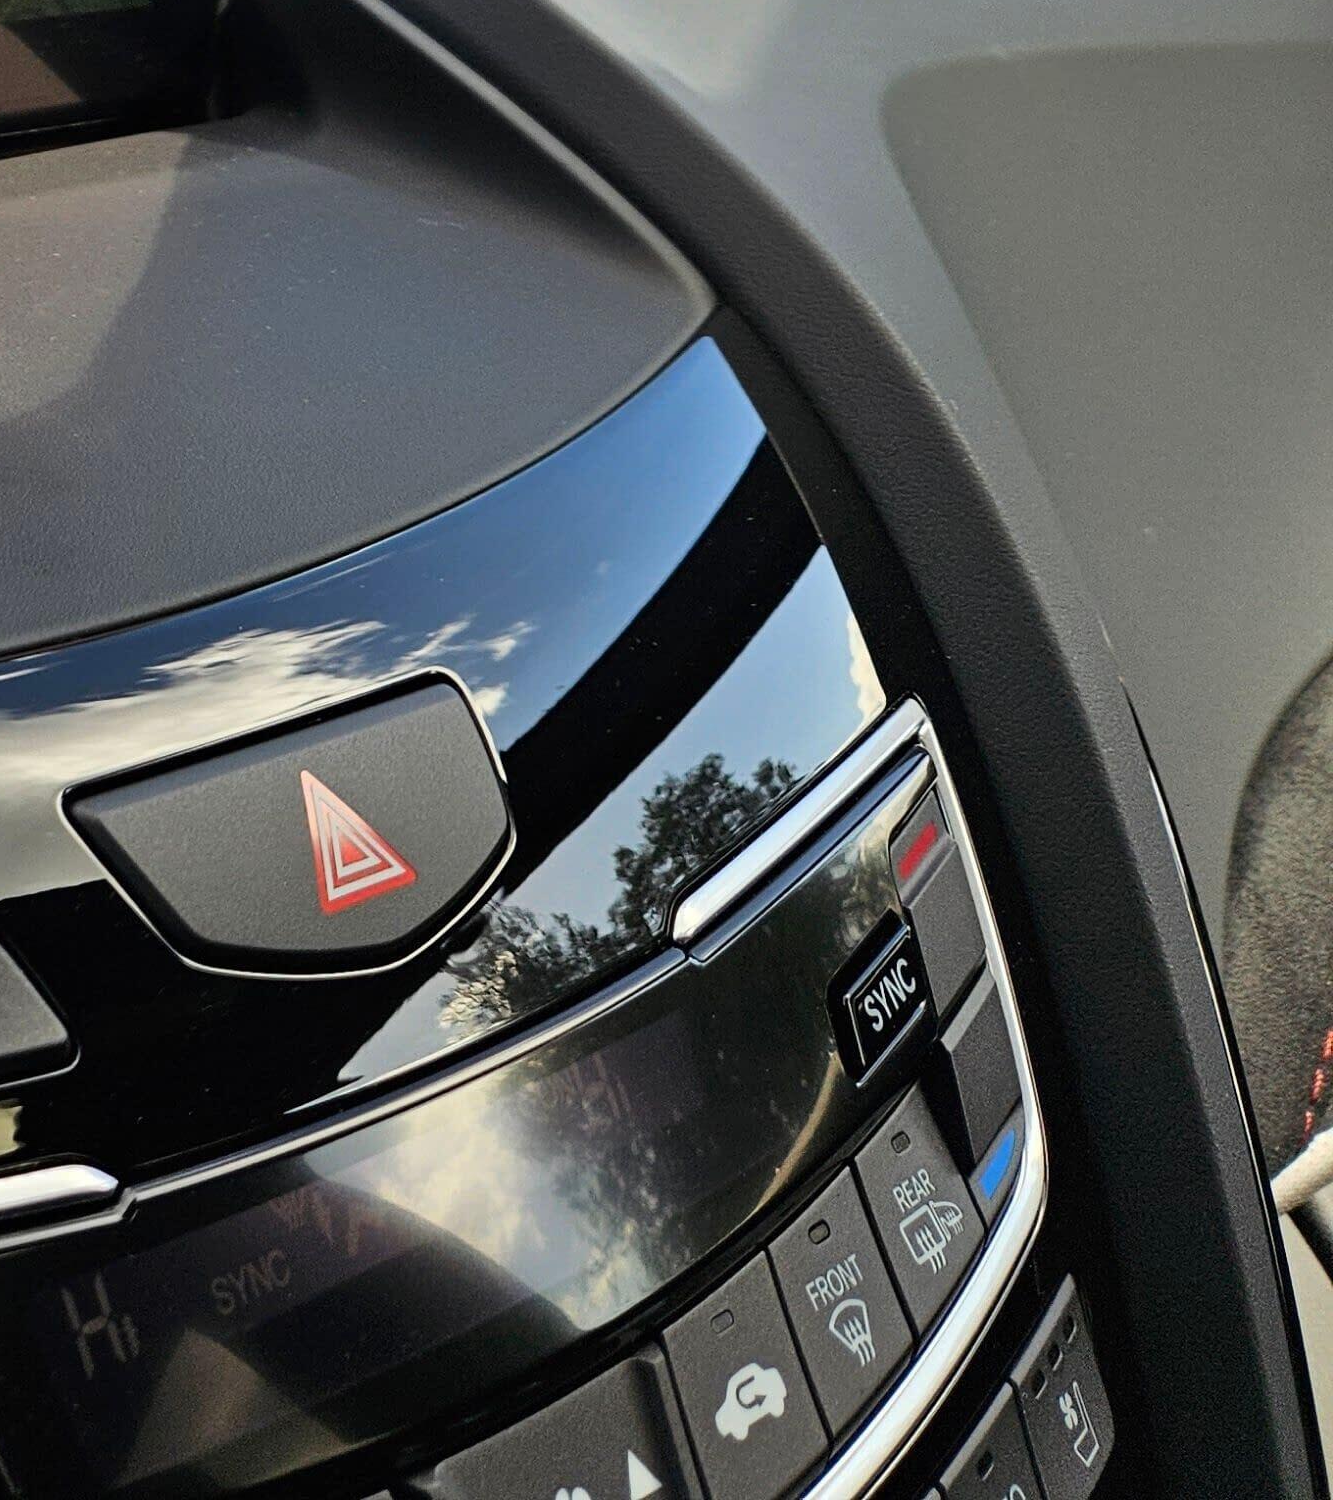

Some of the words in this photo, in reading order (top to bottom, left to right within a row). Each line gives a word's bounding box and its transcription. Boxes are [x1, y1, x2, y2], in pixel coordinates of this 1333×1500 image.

[863, 959, 918, 1033] SYNC
[893, 1169, 935, 1210] REAR
[209, 1248, 293, 1317] SYNC
[805, 1254, 862, 1311] FRONT
